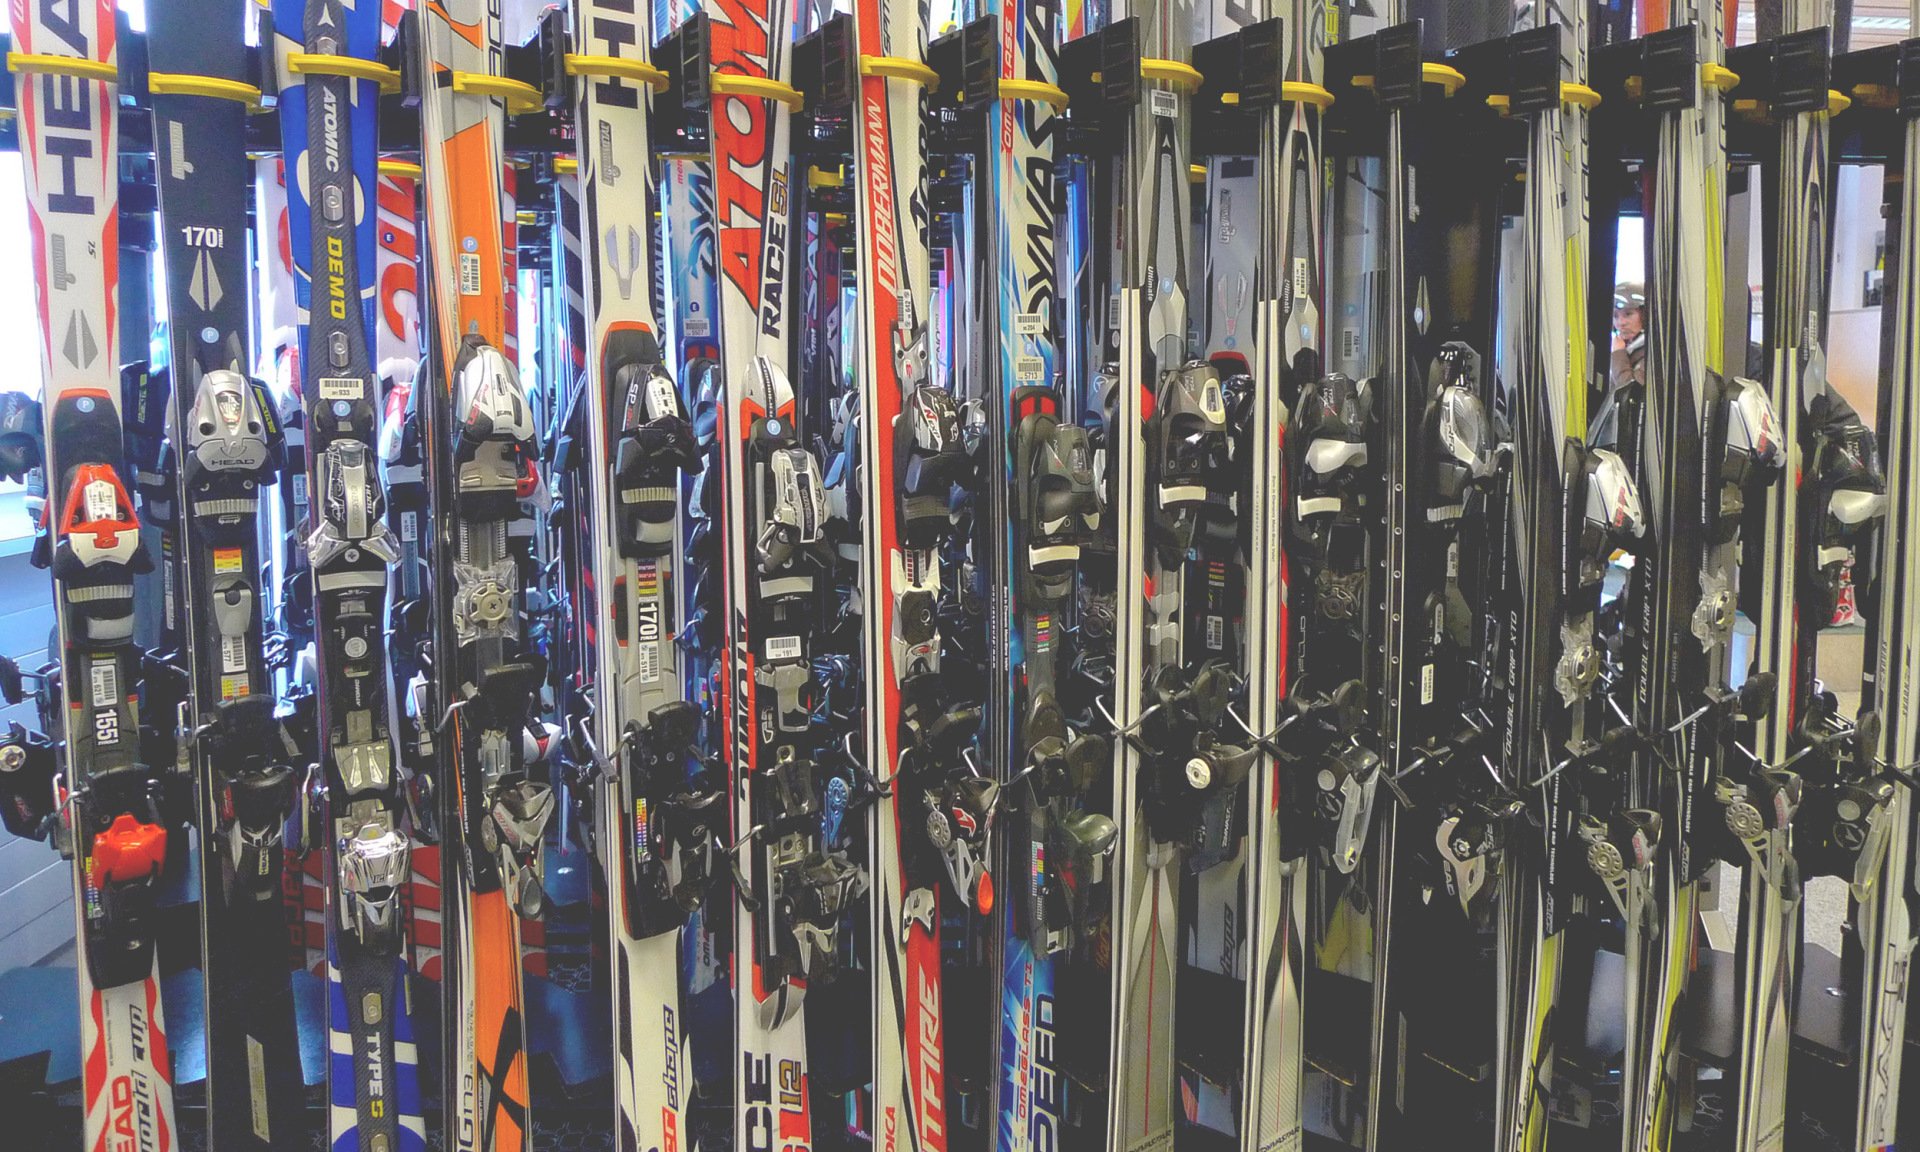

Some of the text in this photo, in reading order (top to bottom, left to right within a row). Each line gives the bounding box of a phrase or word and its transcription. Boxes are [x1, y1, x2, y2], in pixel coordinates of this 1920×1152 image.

[322, 86, 339, 173] ATOMIC
[866, 99, 905, 297] DOBERMANN
[182, 226, 218, 248] 170
[328, 235, 346, 320] DEMO
[761, 219, 787, 339] RACE
[211, 458, 255, 466] HEAD
[640, 603, 658, 636] 170
[1506, 648, 1516, 687] GRIP
[96, 710, 113, 742] 155
[1504, 689, 1514, 755] DOUBLE
[365, 1032, 383, 1095] TYPE
[779, 1059, 802, 1106] 12
[1018, 1011, 1033, 1119] OMEGLASS
